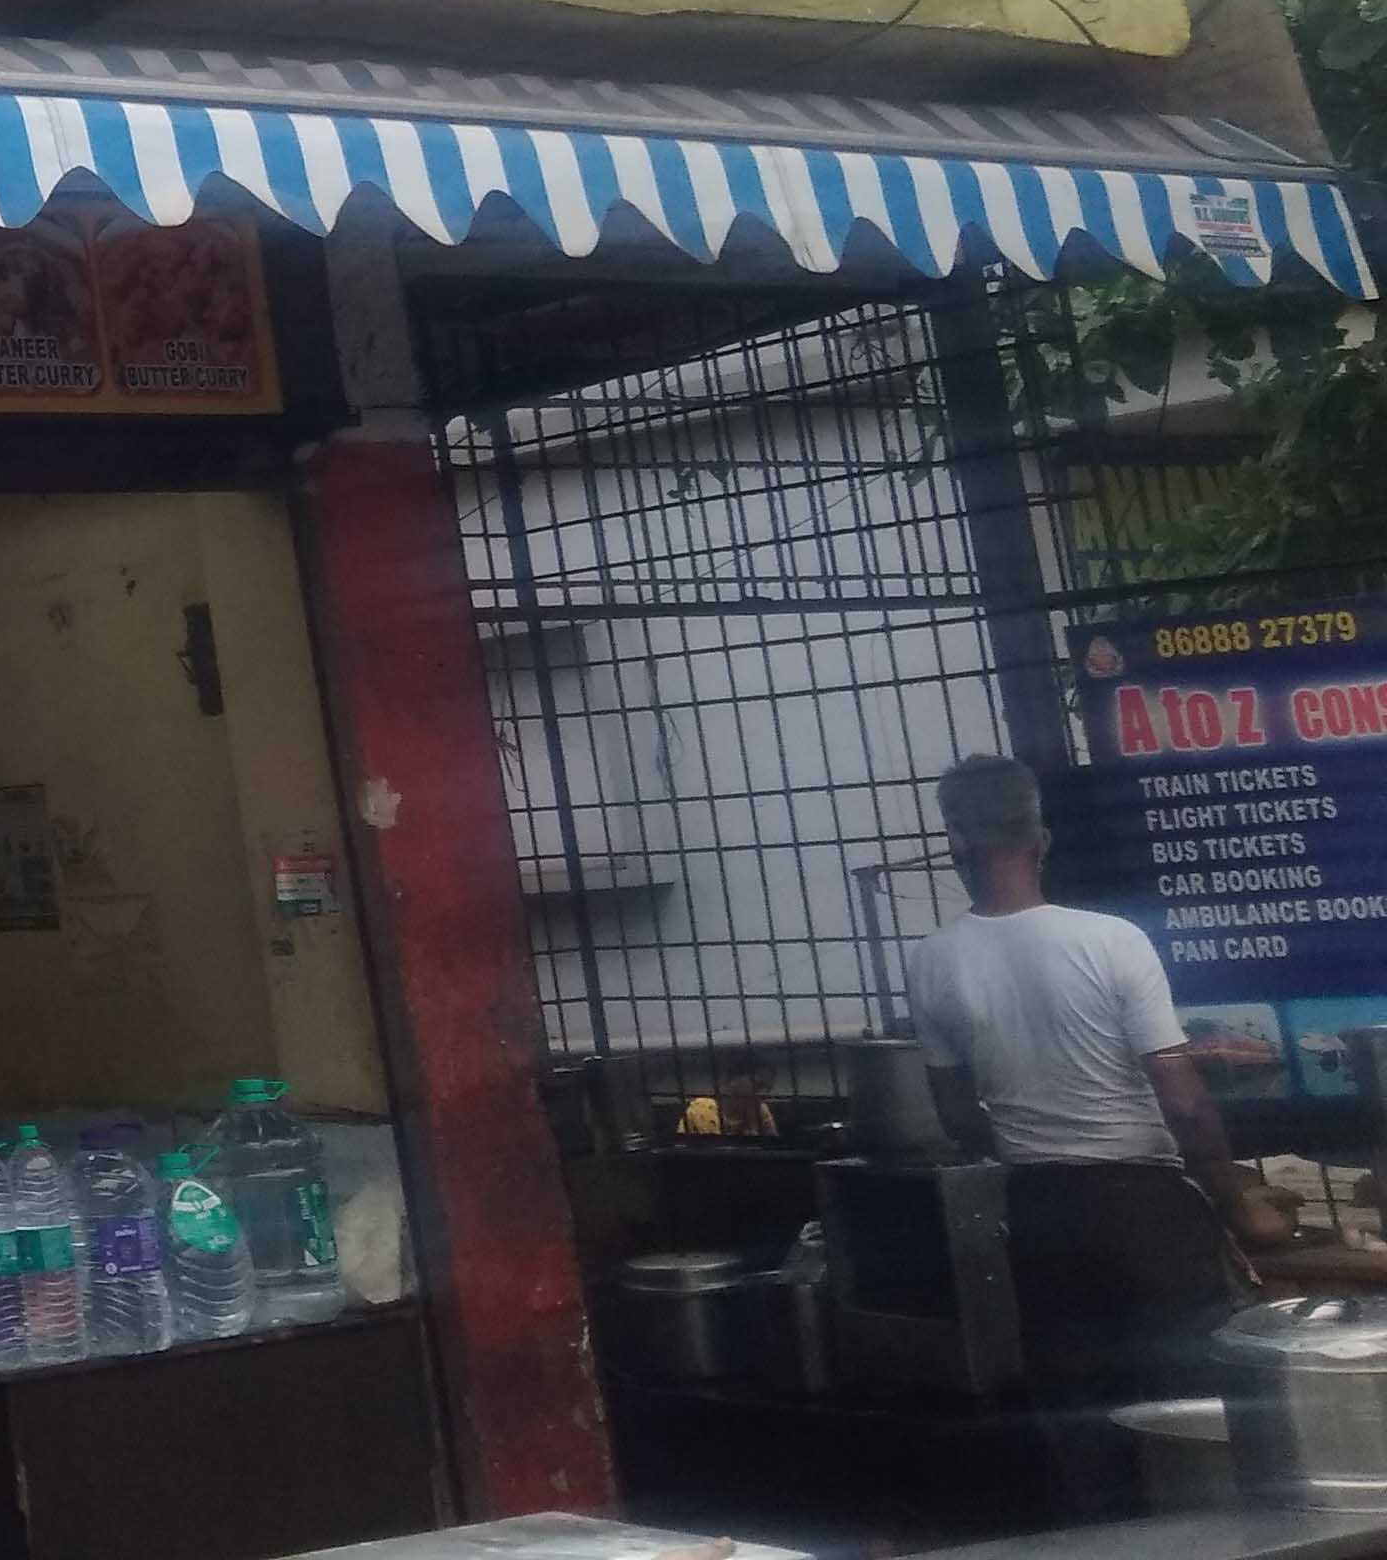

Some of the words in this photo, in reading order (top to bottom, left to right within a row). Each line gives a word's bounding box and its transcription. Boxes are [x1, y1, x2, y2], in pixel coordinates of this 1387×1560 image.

[34, 364, 96, 386] CURRY
[128, 366, 191, 387] BUTTER
[196, 366, 248, 388] CURRY
[1155, 621, 1252, 658] 86888
[1259, 611, 1357, 649] 27379
[1139, 773, 1210, 798] TRAIN
[1214, 765, 1317, 793] TICKETS
[1145, 804, 1227, 831] FLIGHT
[1234, 797, 1337, 824] TICKETS
[1152, 841, 1199, 863] BUS
[1202, 833, 1306, 860] TICKETS
[1158, 873, 1206, 896] CAR
[1211, 865, 1322, 893] BOOKING
[1165, 900, 1311, 929] AMBULANCE
[1171, 939, 1219, 962] PAN
[1224, 935, 1289, 960] CARD
